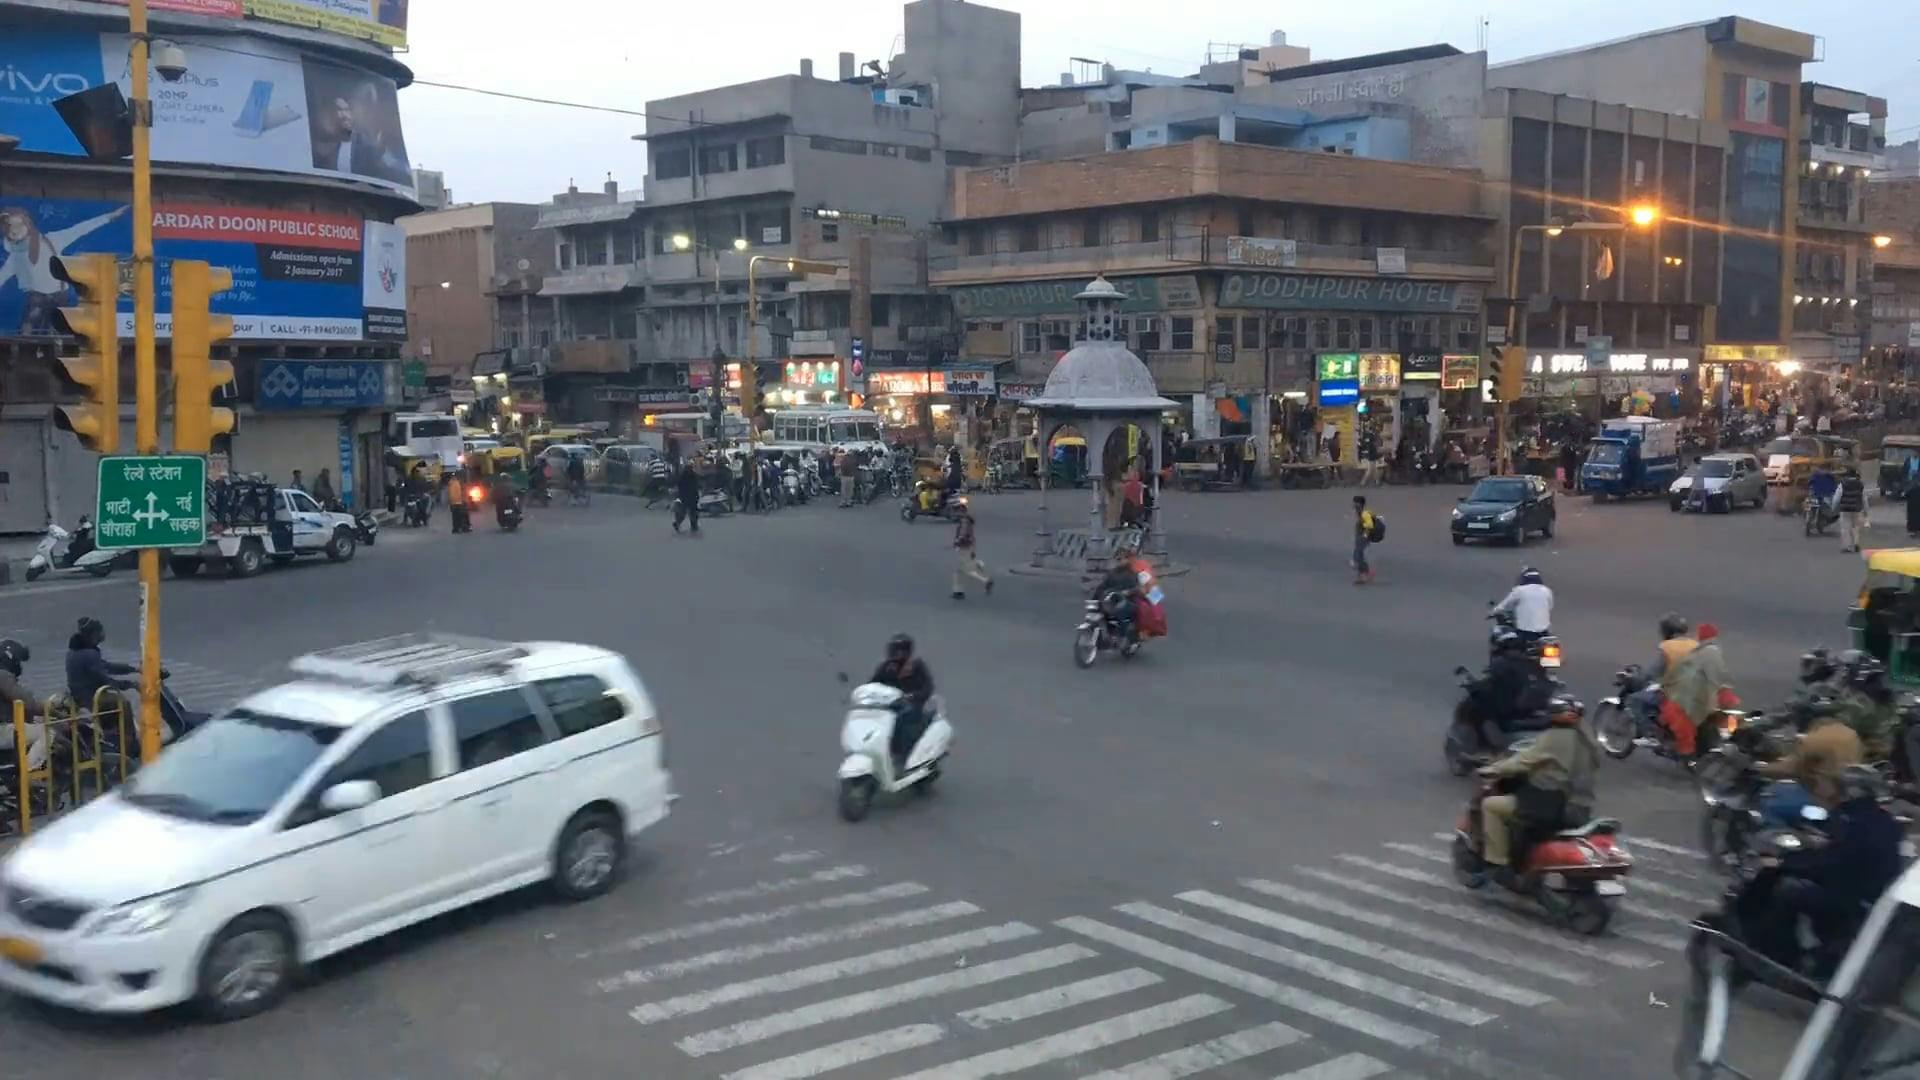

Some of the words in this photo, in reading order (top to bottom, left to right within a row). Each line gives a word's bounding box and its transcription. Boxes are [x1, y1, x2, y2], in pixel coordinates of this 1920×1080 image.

[0, 64, 89, 95] ivo
[153, 212, 215, 229] ARDAR
[219, 215, 267, 233] DOON
[269, 219, 317, 236] PUBLIC
[318, 223, 361, 241] SCHOOL
[270, 249, 318, 263] Admissions
[318, 256, 337, 266] open
[284, 264, 291, 275] 2
[290, 264, 326, 278] January
[326, 266, 344, 277] 2017
[971, 282, 1069, 309] JODHPUR
[1245, 274, 1371, 301] JODHPUR
[1378, 280, 1450, 304] HOTEL
[270, 324, 297, 335] CALL:
[148, 463, 182, 481] स्टेशन
[175, 491, 193, 513] नई
[100, 518, 137, 537] चौराहा
[169, 517, 200, 535] सड़क
